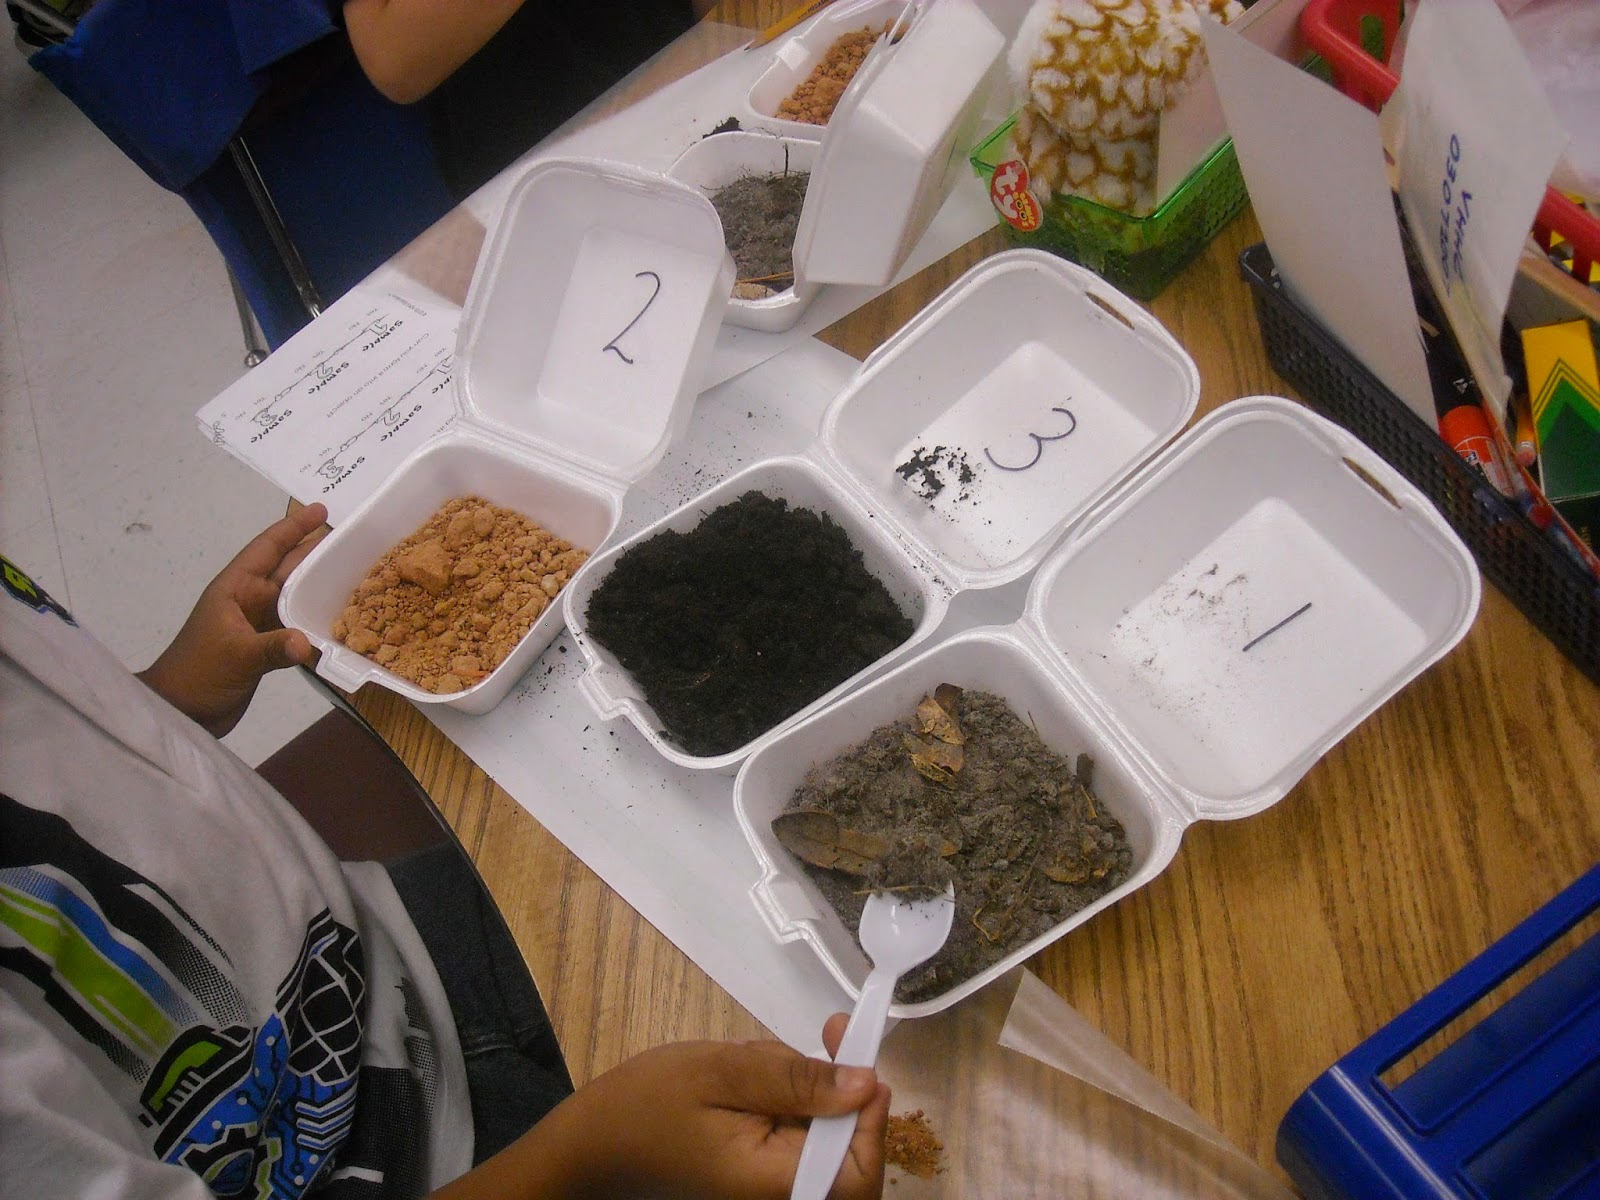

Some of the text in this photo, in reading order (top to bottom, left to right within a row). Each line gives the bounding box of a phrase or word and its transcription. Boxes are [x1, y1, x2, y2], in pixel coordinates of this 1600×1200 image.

[994, 165, 1019, 219] ty
[413, 332, 430, 347] Can
[602, 271, 661, 364] 2
[251, 320, 403, 443] Sample Sample Sample
[363, 375, 379, 388] into
[381, 405, 422, 441] Sample
[983, 407, 1077, 472] 3
[323, 457, 365, 493] Sample
[1242, 602, 1312, 652] 1
